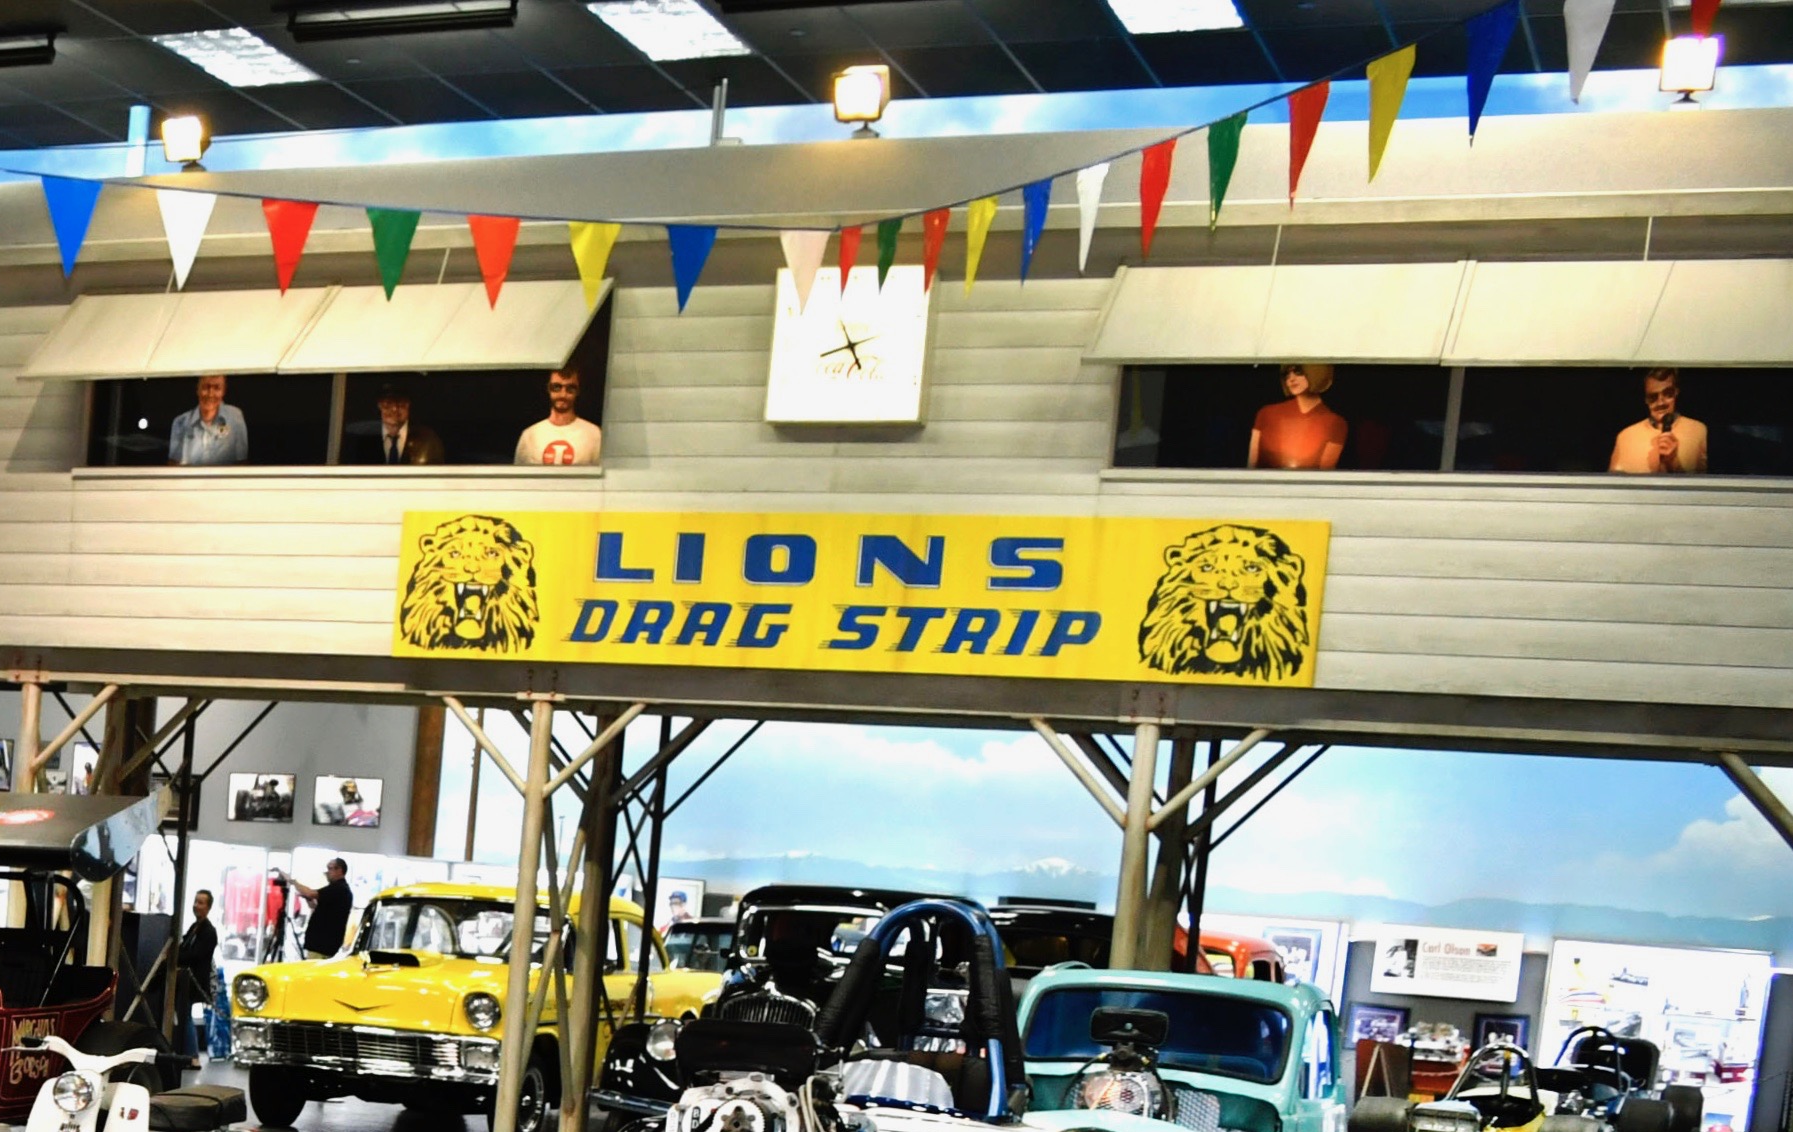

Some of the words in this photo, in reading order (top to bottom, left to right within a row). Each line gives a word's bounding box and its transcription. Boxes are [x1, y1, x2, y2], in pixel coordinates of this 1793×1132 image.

[594, 532, 1064, 590] LIONS
[561, 598, 793, 648] DRAG
[819, 604, 1102, 657] STRIP
